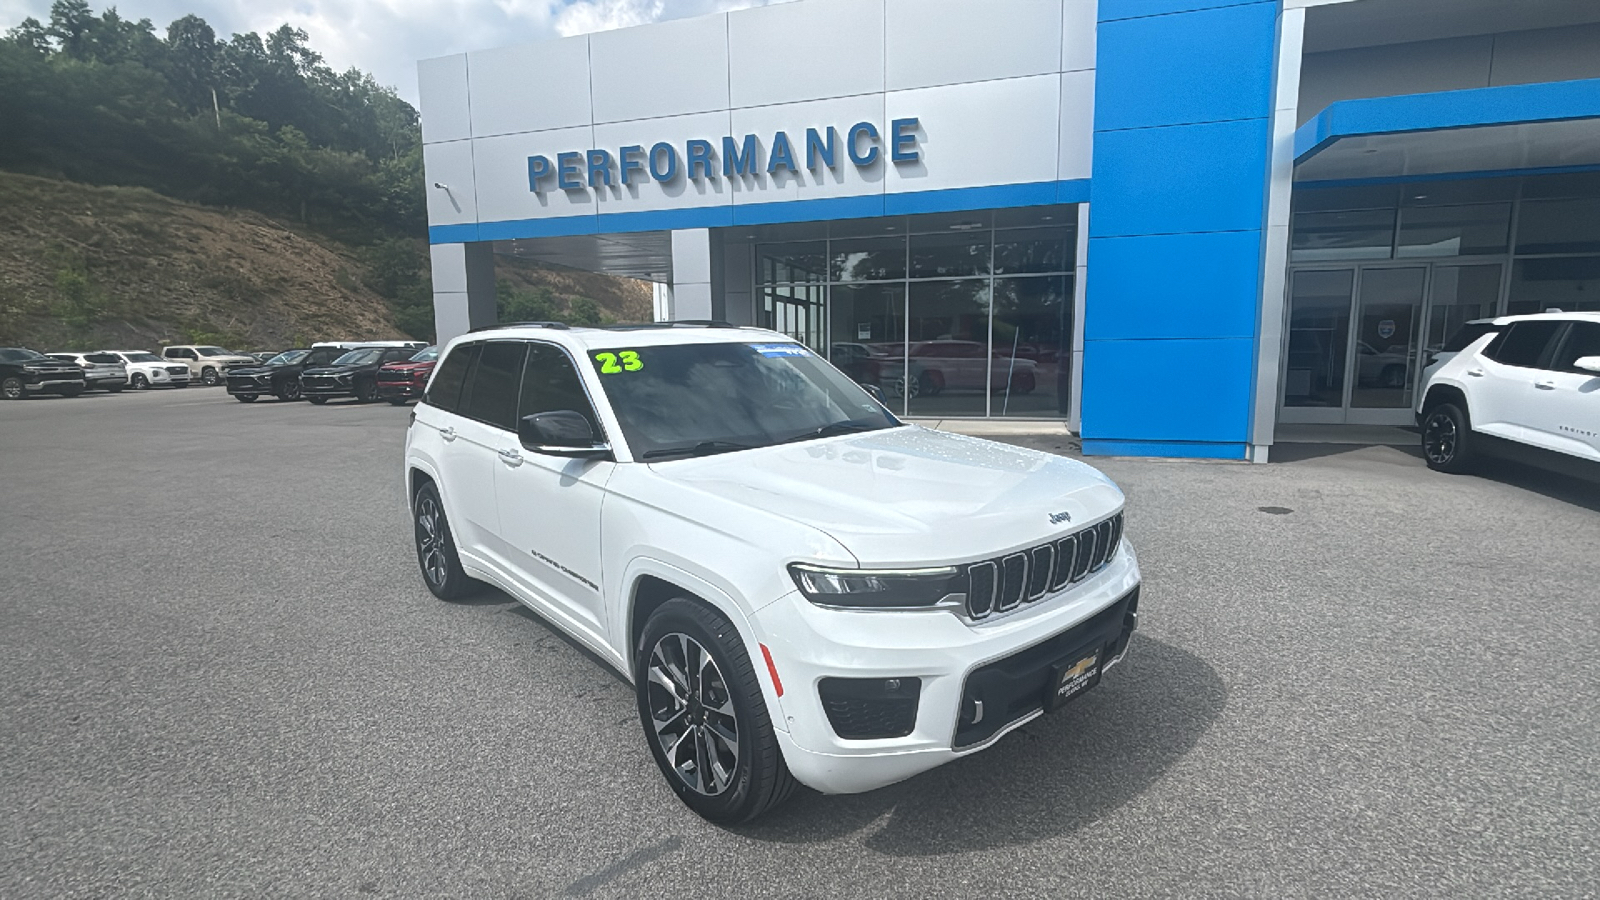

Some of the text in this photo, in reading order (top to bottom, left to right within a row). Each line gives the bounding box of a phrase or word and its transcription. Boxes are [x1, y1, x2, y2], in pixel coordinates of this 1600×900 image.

[527, 117, 921, 194] PERFORMANCE
[595, 351, 643, 374] 23
[1048, 511, 1071, 525] Jeep
